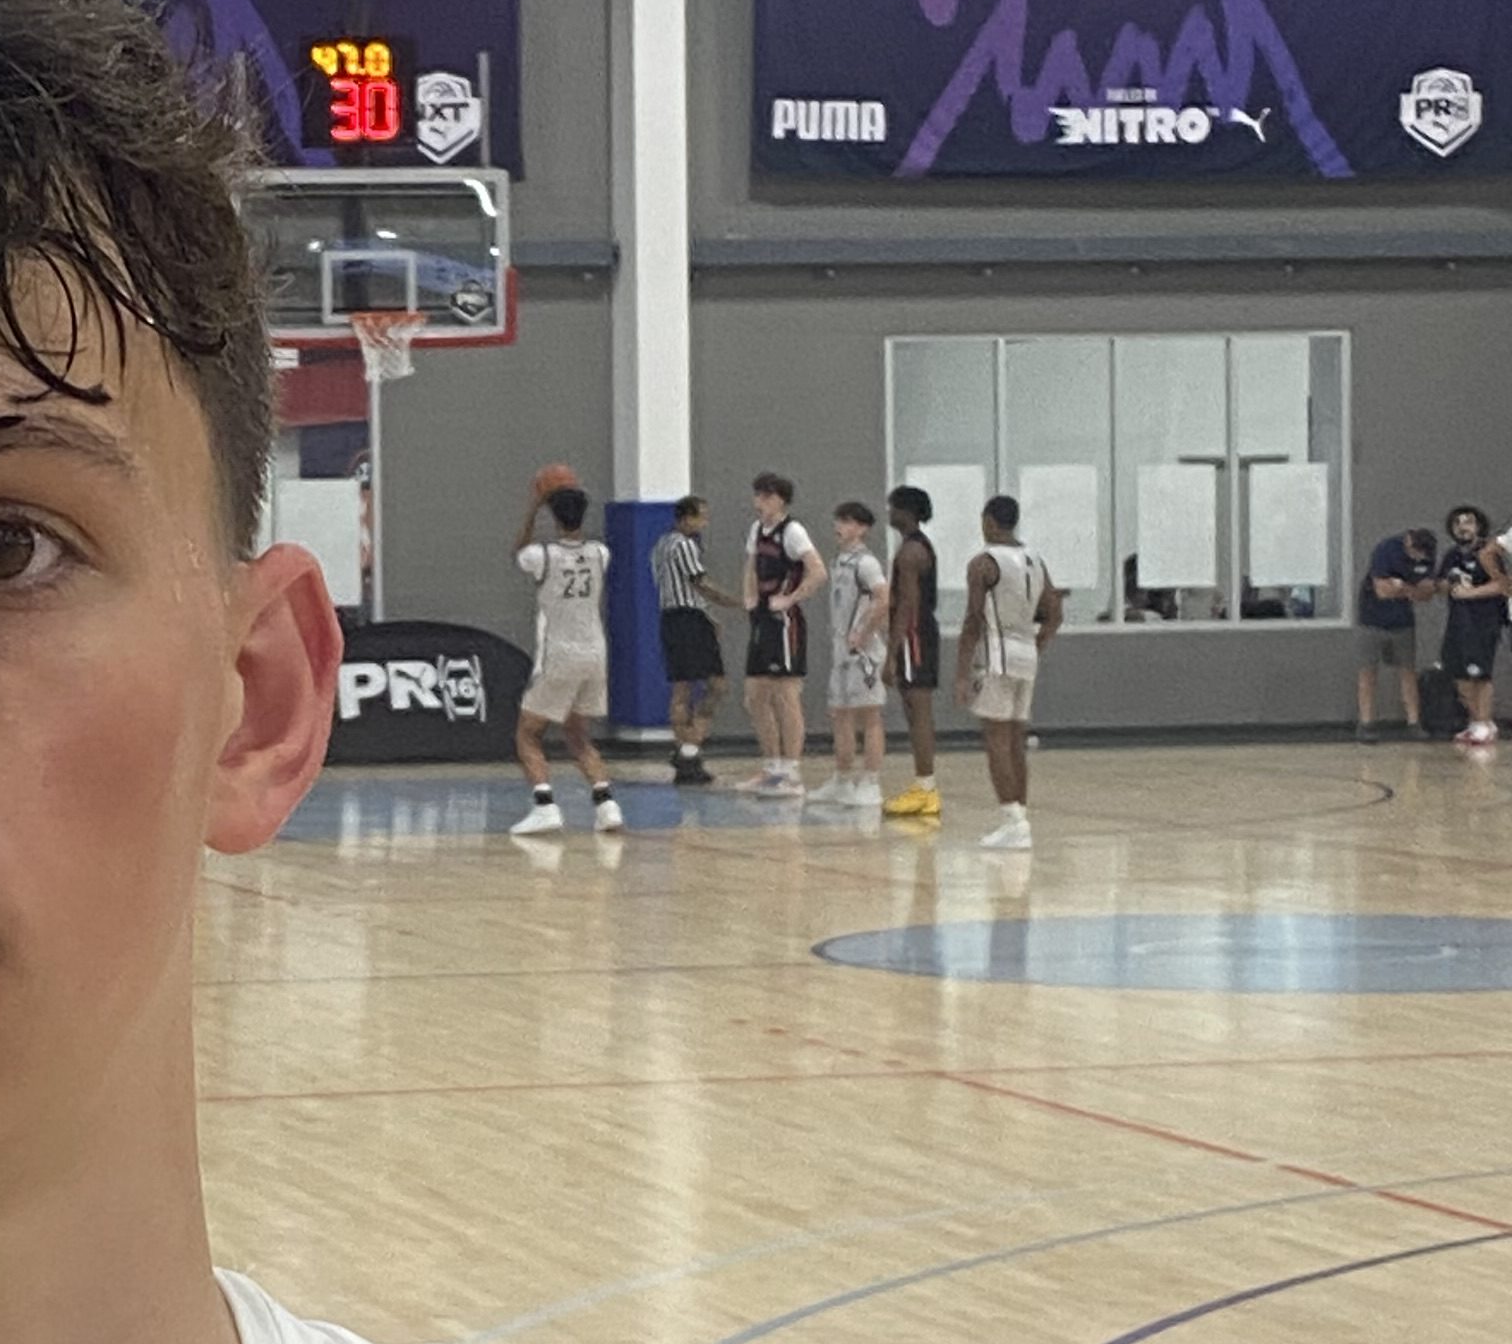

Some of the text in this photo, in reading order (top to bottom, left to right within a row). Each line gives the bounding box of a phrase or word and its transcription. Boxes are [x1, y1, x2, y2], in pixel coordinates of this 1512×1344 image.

[329, 77, 400, 141] 30
[772, 98, 886, 141] PUMA
[1048, 106, 1211, 144] NITRO
[561, 568, 592, 599] 23
